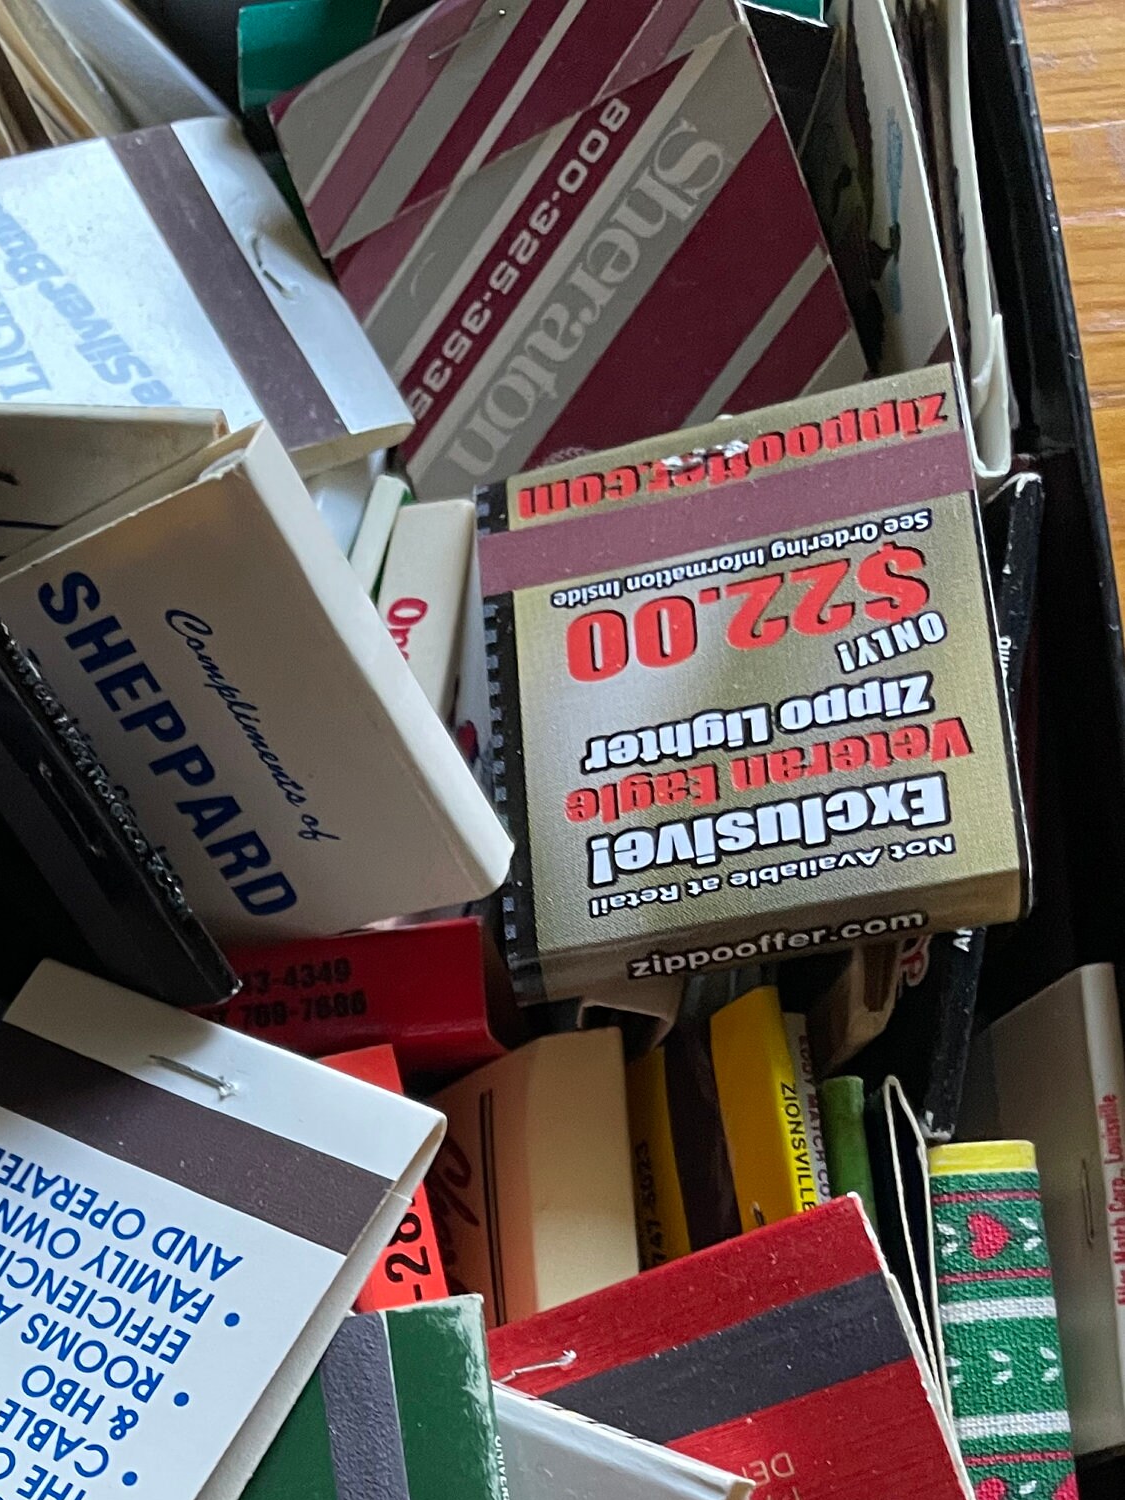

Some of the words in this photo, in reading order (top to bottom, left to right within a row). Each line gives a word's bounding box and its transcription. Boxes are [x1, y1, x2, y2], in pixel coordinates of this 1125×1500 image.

[440, 108, 735, 501] Sheraton
[507, 386, 953, 525] zippooffer.com
[768, 519, 879, 561] Ordering
[881, 509, 932, 536] See
[549, 577, 621, 608] Inside
[623, 545, 765, 593] Information
[553, 535, 935, 687] $22.00
[831, 608, 950, 673] ONLY!
[164, 607, 309, 806] Compliments
[299, 811, 340, 843] of
[577, 700, 774, 776] Lighter
[773, 669, 934, 738] Zippo
[23, 557, 311, 933] SHEPPARD
[724, 713, 973, 801] Veteran
[558, 758, 721, 833] Eagle
[582, 768, 951, 890] Exclusive!
[726, 842, 883, 893] Available
[889, 832, 954, 862] Not
[586, 880, 680, 915] Retail
[686, 874, 720, 897] at
[628, 905, 927, 982] zippooffer.com
[778, 1078, 816, 1216] ZIONSVILLE
[805, 1091, 827, 1163] MATCH
[1095, 1090, 1125, 1166] Louisville
[76, 1236, 218, 1328] FAMILY
[145, 1218, 246, 1290] AND
[13, 1305, 170, 1407] ROOMS
[14, 1357, 109, 1428] HBO
[99, 1399, 143, 1448] &
